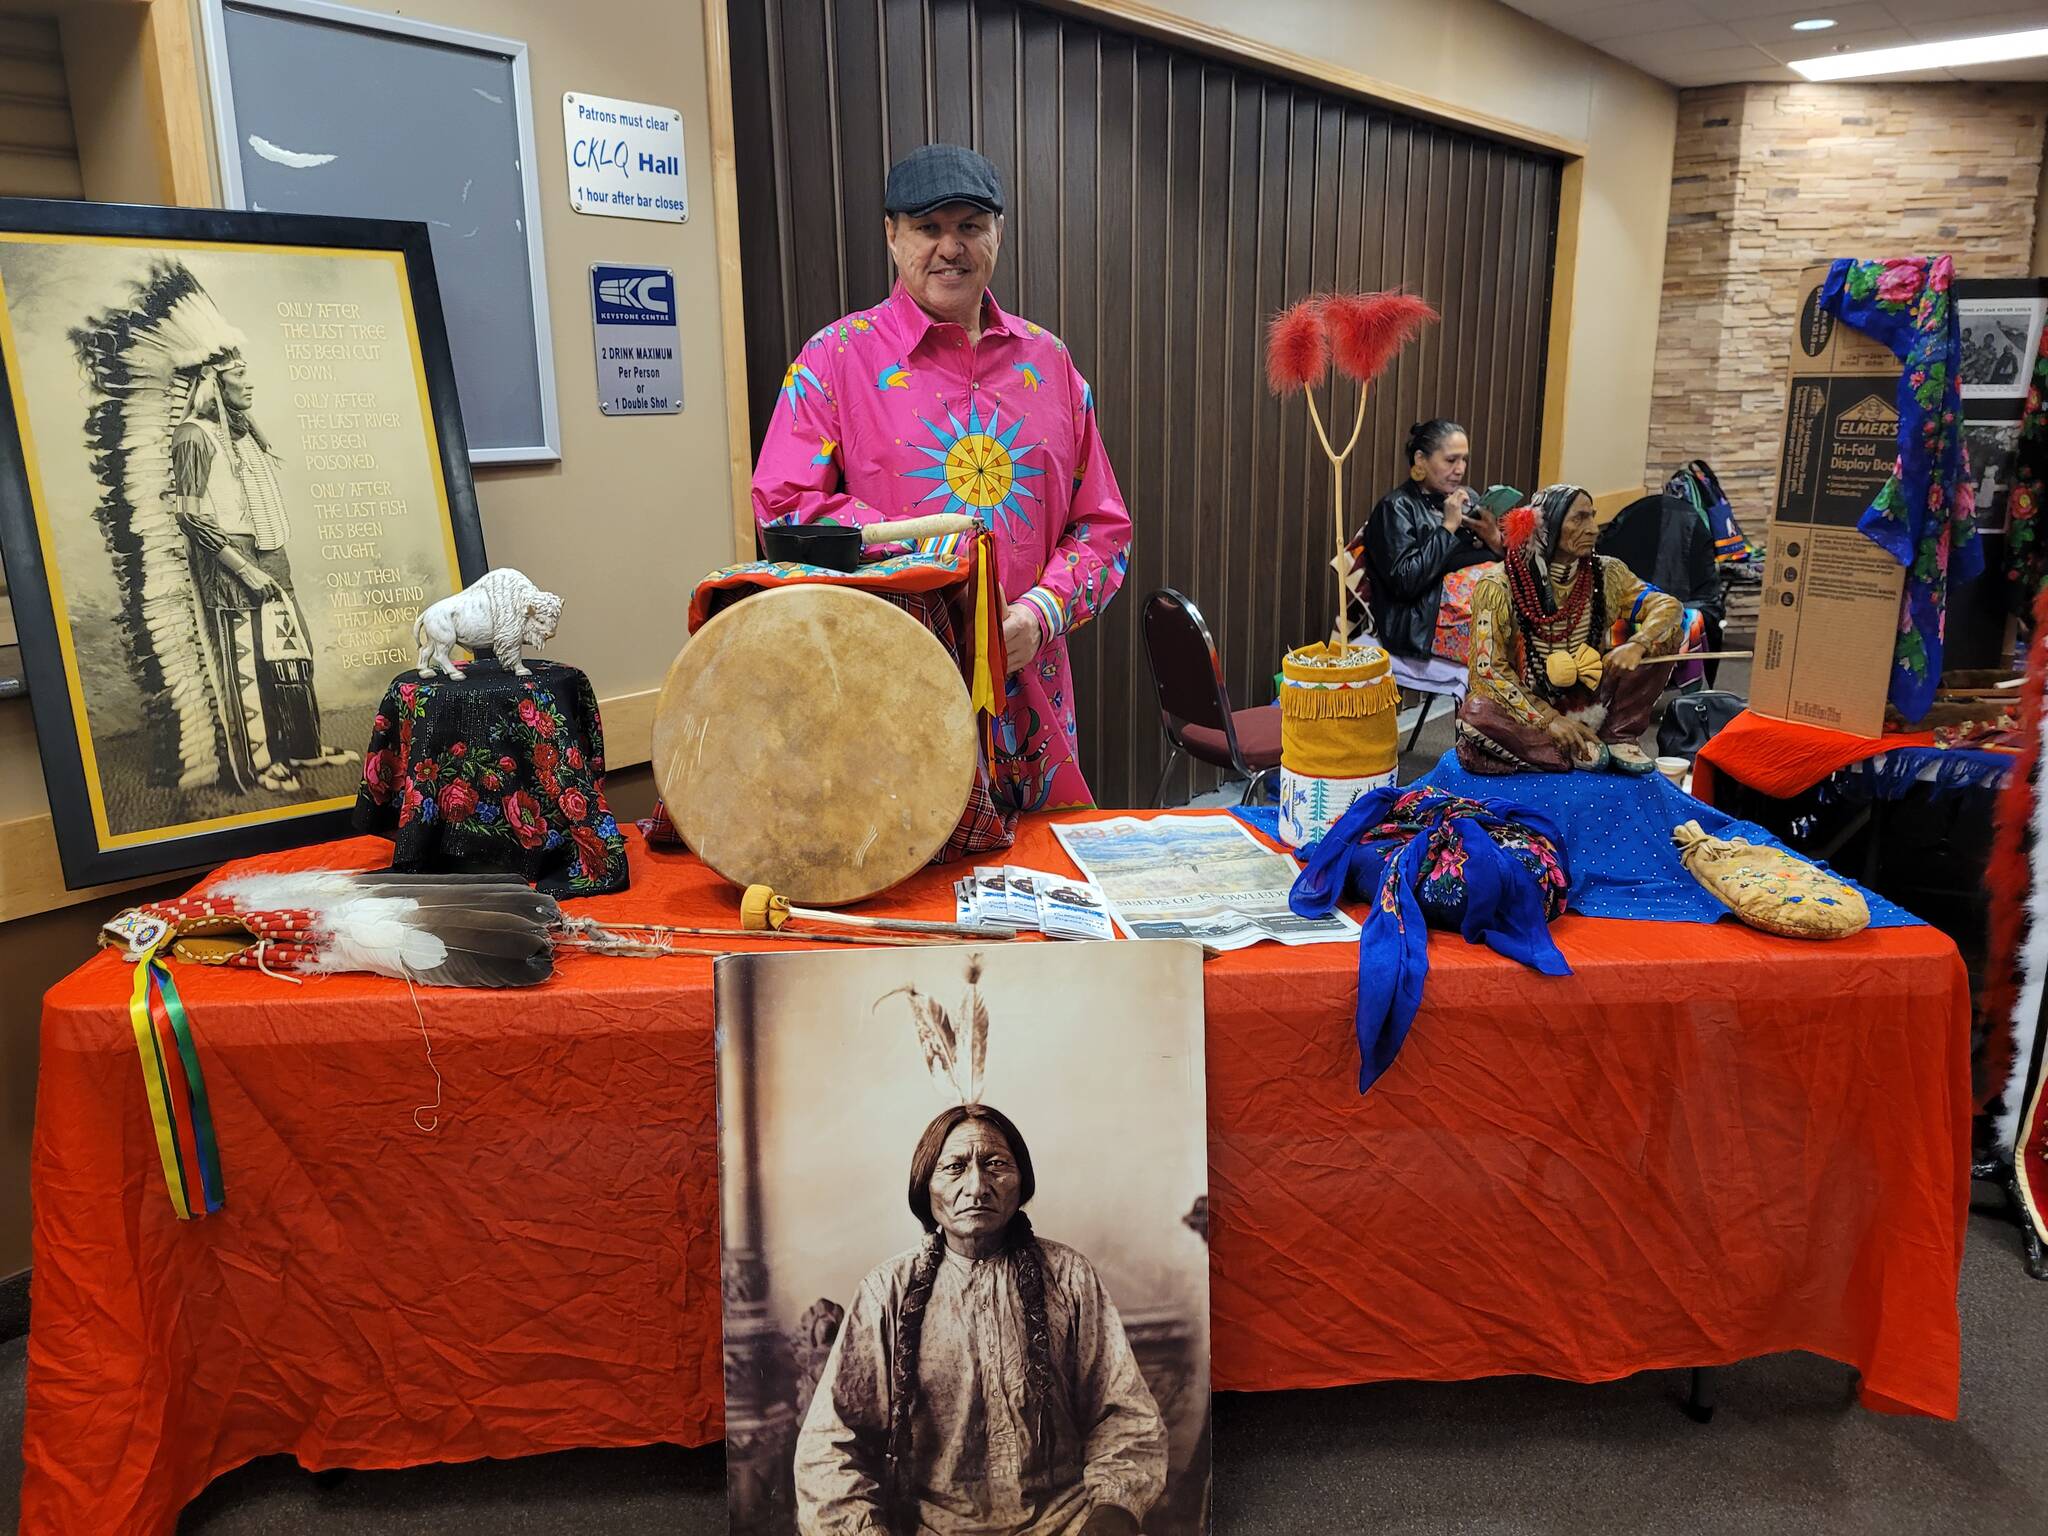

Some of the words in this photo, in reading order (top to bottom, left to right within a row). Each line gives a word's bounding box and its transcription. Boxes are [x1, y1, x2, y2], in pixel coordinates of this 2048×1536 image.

[578, 105, 616, 124] Patrons
[619, 114, 643, 128] must
[645, 116, 669, 132] clear
[573, 137, 629, 178] CKLQ
[638, 152, 679, 175] Hall
[578, 186, 583, 200] 1
[586, 187, 608, 203] hour
[611, 190, 634, 205] after
[636, 193, 652, 208] bar
[655, 196, 684, 210] closes
[277, 302, 313, 318] ONLY
[316, 303, 361, 319] AFTER
[280, 323, 310, 338] THE
[312, 324, 345, 340] LAST
[350, 324, 386, 340] TREE
[284, 344, 312, 360] HAS
[314, 344, 351, 360] BEEN
[352, 345, 381, 360] CUT
[602, 348, 607, 360] 2
[609, 348, 634, 360] DRINK
[636, 348, 673, 360] MAXIMUM
[618, 366, 631, 378] Per
[633, 367, 660, 378] Person
[636, 385, 645, 393] or
[294, 392, 330, 409] ONLY
[334, 393, 376, 408] AFTER
[615, 398, 619, 409] 1
[622, 398, 648, 410] Double
[650, 398, 668, 409] Shot
[297, 413, 327, 429] THE
[330, 413, 361, 429] LAST
[365, 413, 401, 428] RIVER
[1839, 422, 1899, 436] ELMER'S
[302, 434, 329, 450] HAS
[331, 434, 367, 449] BEEN
[1832, 443, 1876, 456] Tri-Fold
[1830, 457, 1872, 472] Display
[310, 483, 346, 499] ONLY
[349, 480, 392, 497] AFTER
[313, 504, 342, 520] THE
[345, 502, 377, 517] LAST
[379, 499, 408, 517] FISH
[317, 524, 345, 540] HAS
[347, 522, 383, 538] BEEN
[326, 570, 361, 588] ONLY
[364, 568, 401, 584] THEN
[330, 591, 363, 608] WILL
[363, 588, 394, 605] YOU
[395, 586, 424, 602] FIND
[333, 611, 369, 629] THAT
[373, 605, 420, 625] MONEY
[337, 628, 393, 649] CANNOT
[342, 652, 361, 669] BE
[362, 647, 412, 666] EATEN.
